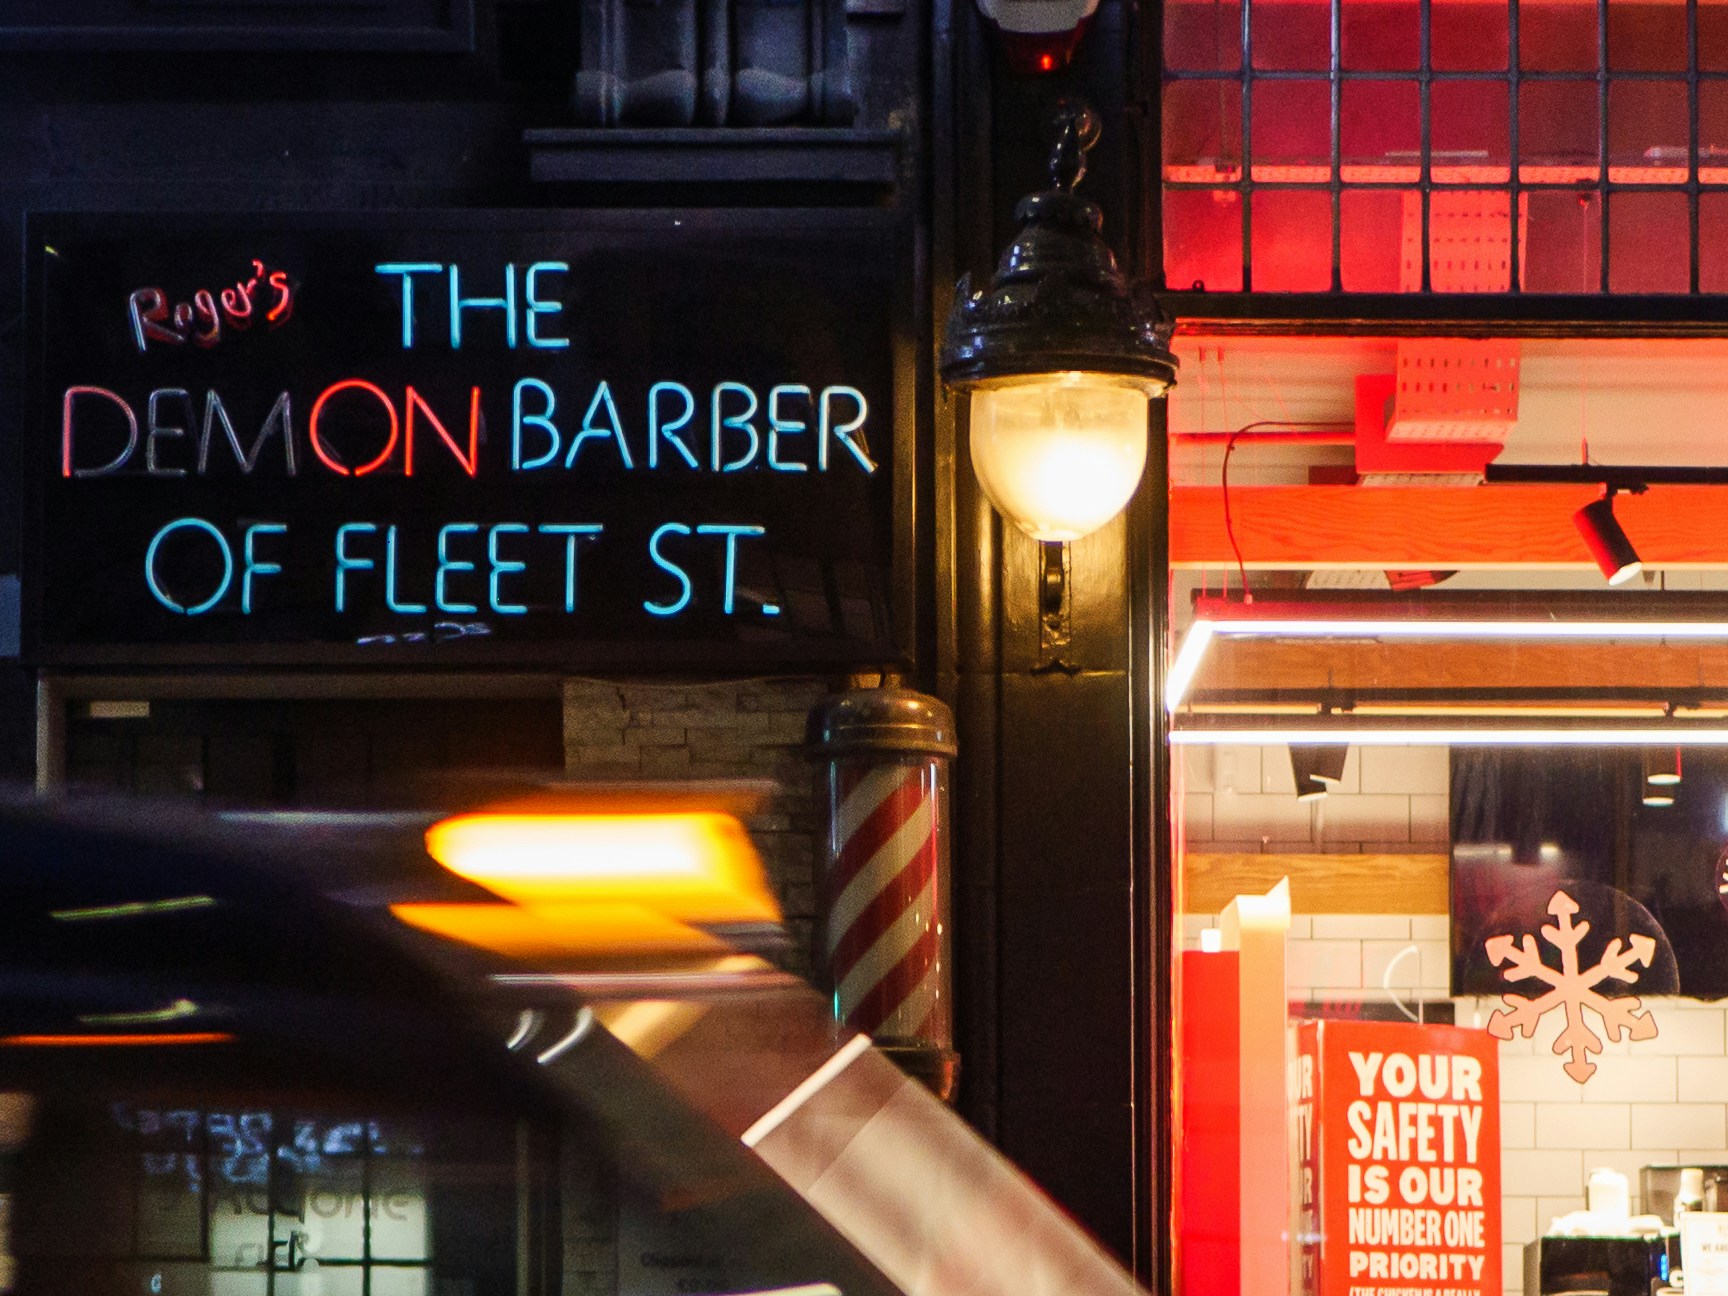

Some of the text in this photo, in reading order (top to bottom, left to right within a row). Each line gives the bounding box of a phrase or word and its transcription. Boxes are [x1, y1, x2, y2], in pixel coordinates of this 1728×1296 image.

[128, 258, 294, 353] Roger's
[374, 260, 571, 351] THE
[62, 376, 879, 479] DEMON BARBER
[144, 517, 782, 617] OF FLEET ST.
[1347, 1051, 1483, 1102] YOUR
[1347, 1100, 1483, 1164] SAFETY
[1347, 1164, 1484, 1206] IS OUR
[1348, 1207, 1485, 1248] NUMBER ONE
[1349, 1250, 1485, 1281] PRIORITY
